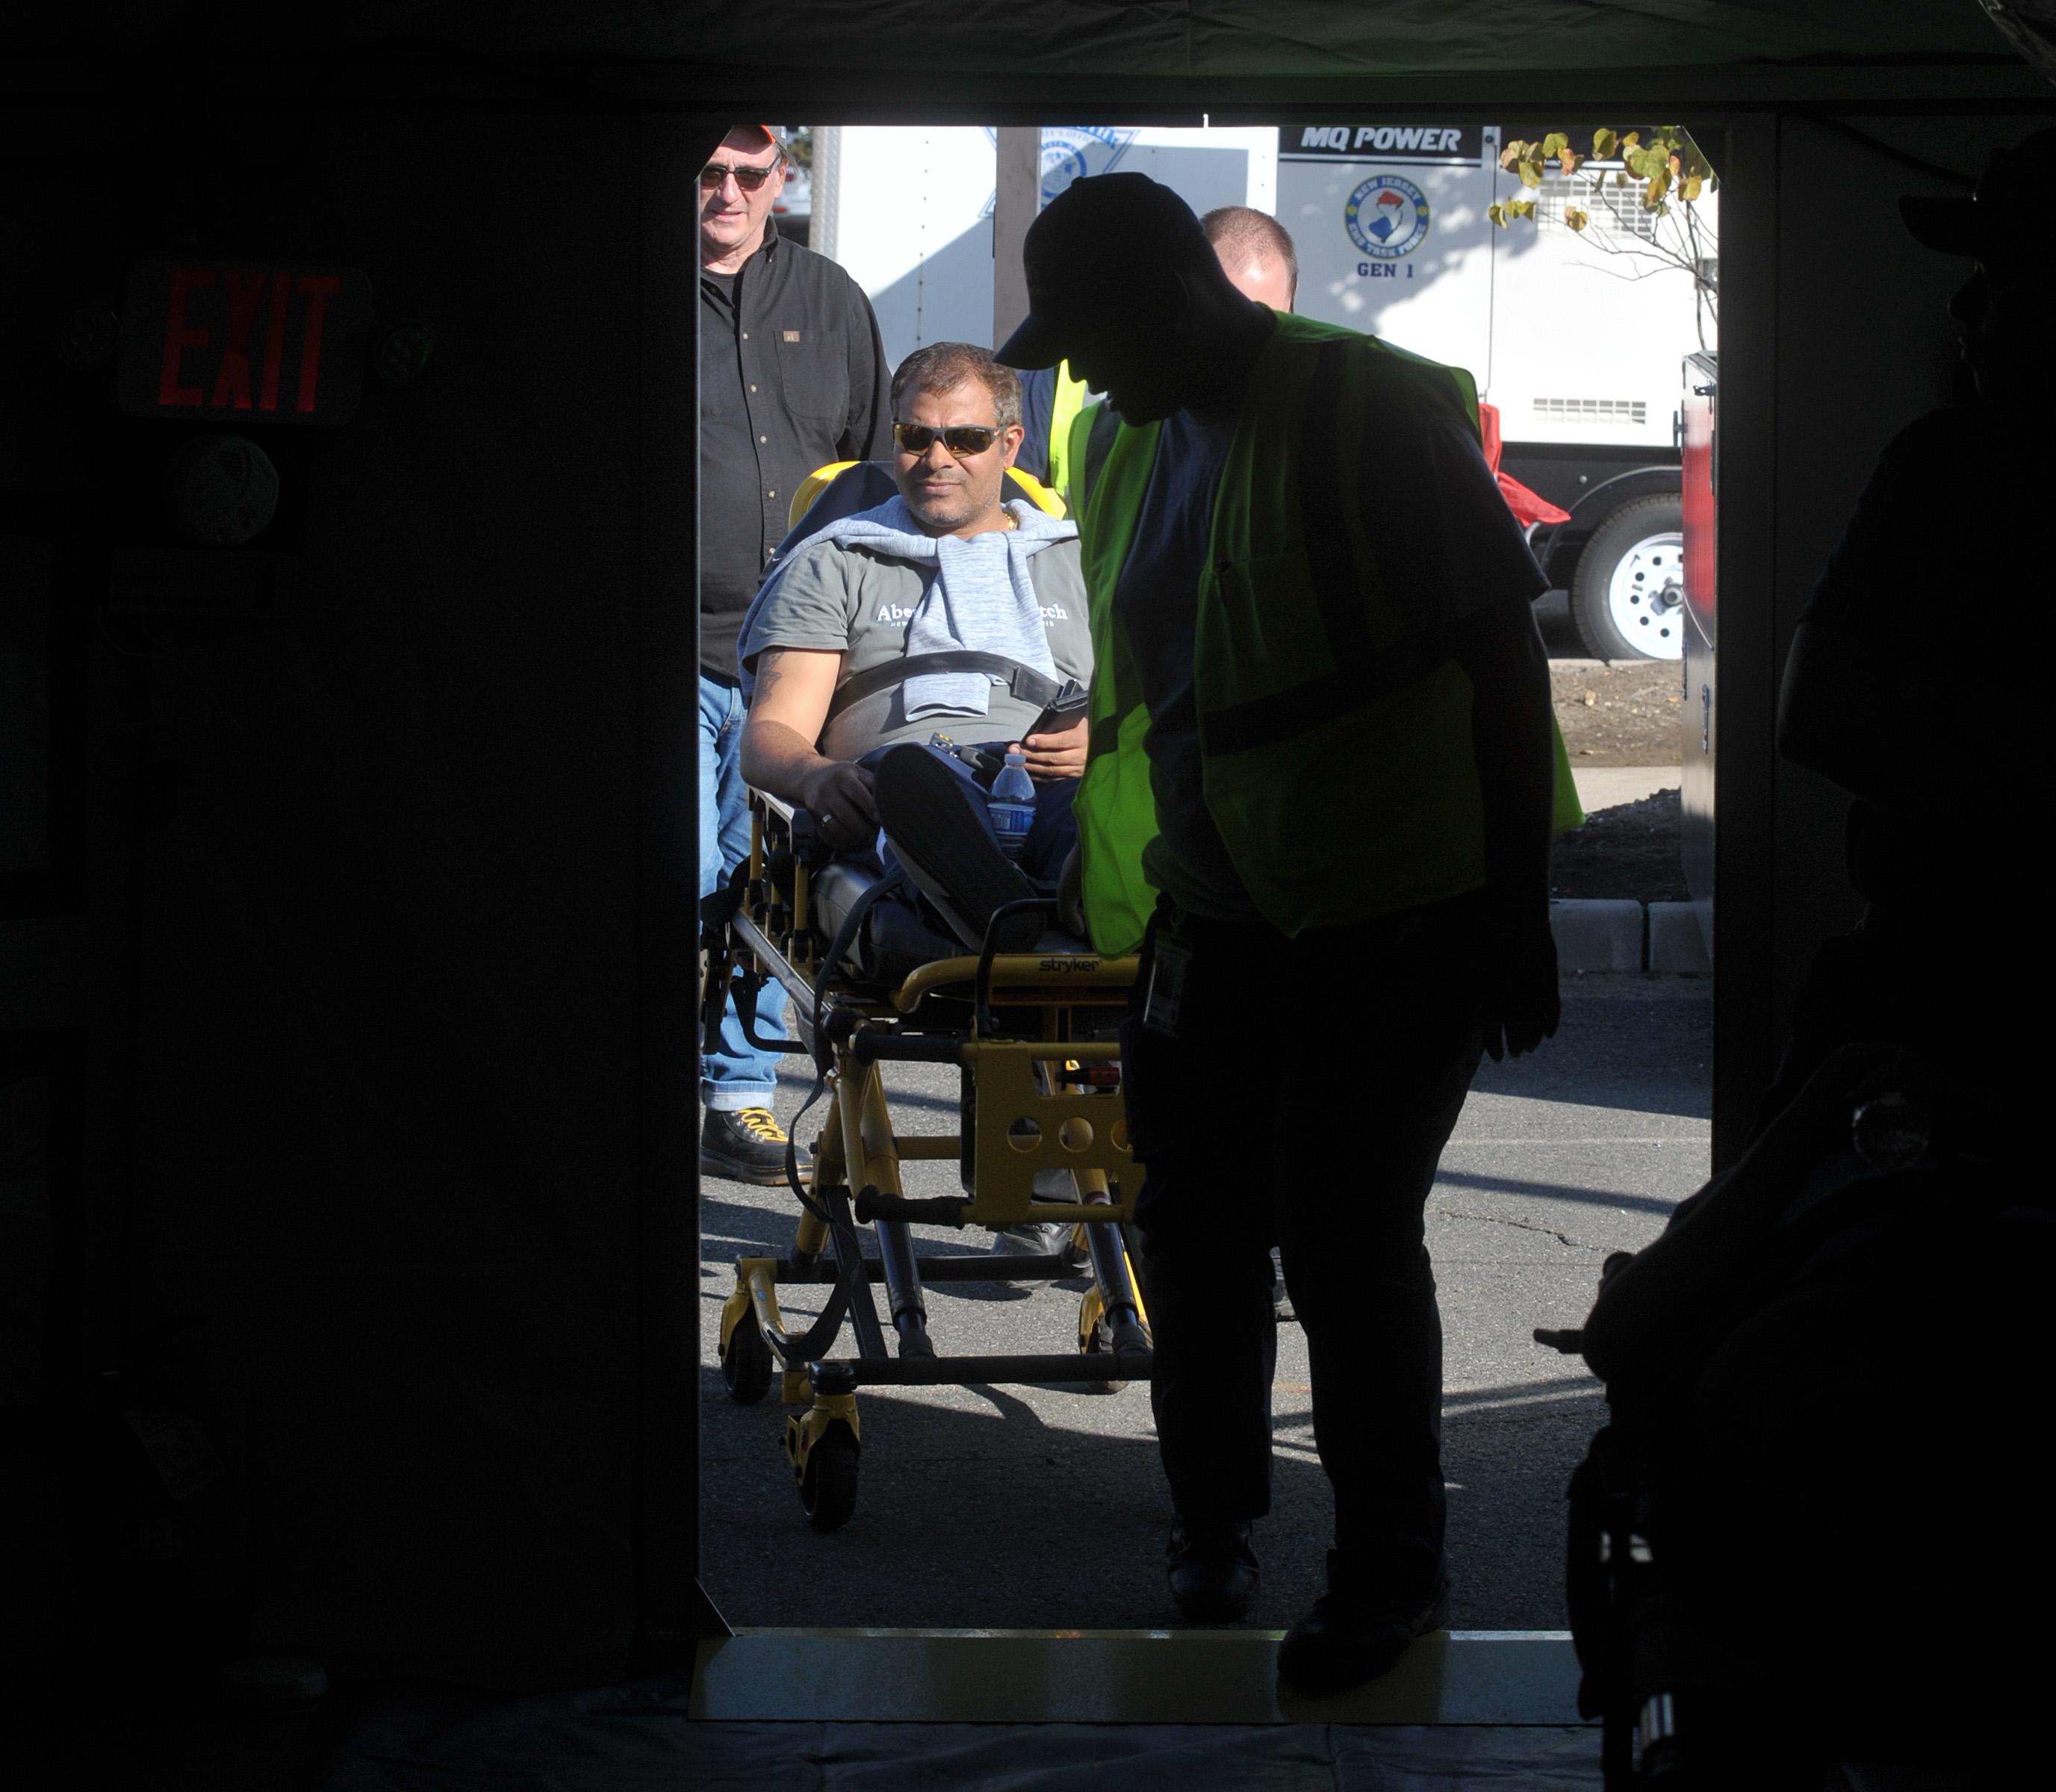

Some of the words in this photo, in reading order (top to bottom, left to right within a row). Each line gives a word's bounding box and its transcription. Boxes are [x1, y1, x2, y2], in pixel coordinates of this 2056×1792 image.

[1300, 127, 1351, 152] MQ
[1353, 127, 1462, 152] POWER
[1354, 178, 1378, 201] NEW
[1382, 177, 1422, 200] JERSEY
[1366, 243, 1397, 257] TASK
[1397, 223, 1426, 255] FORCE
[1357, 262, 1397, 277] GEN
[1407, 264, 1414, 279] 1
[158, 268, 343, 411] EXIT
[1040, 603, 1068, 620] tch
[1039, 957, 1100, 973] stryker
